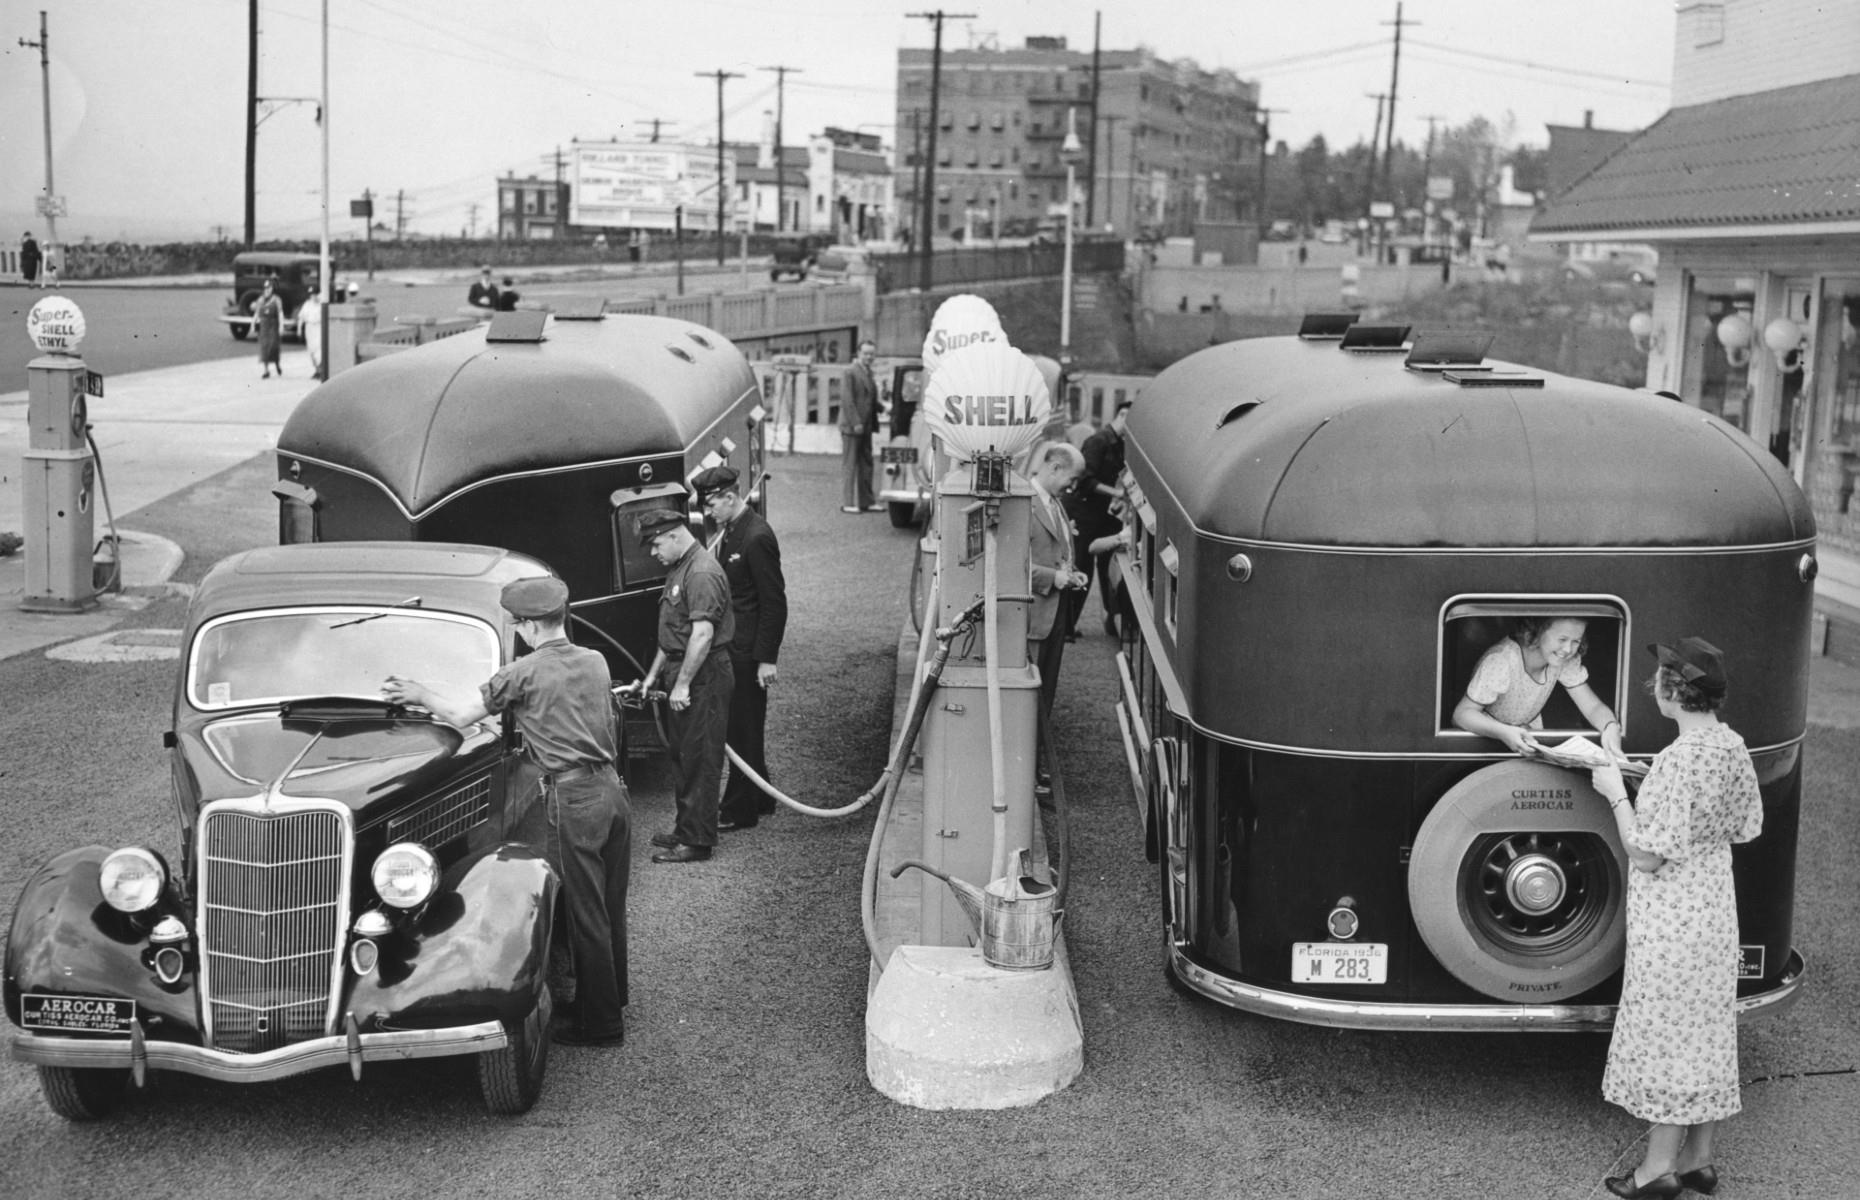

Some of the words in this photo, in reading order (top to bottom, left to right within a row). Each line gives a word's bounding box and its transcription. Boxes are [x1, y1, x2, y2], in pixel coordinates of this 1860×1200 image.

[42, 324, 74, 335] SHELL
[37, 336, 69, 348] ETHYL
[943, 395, 1038, 427] SHELL
[1511, 788, 1572, 799] CURTISS
[1511, 800, 1574, 811] AEROCAR
[1299, 949, 1349, 957] FLORIDA
[1311, 959, 1322, 976] M
[1335, 958, 1369, 978] 283
[1509, 981, 1563, 993] PRIVATE
[42, 999, 116, 1014] AEROCAR
[63, 1013, 102, 1022] AEROCAR
